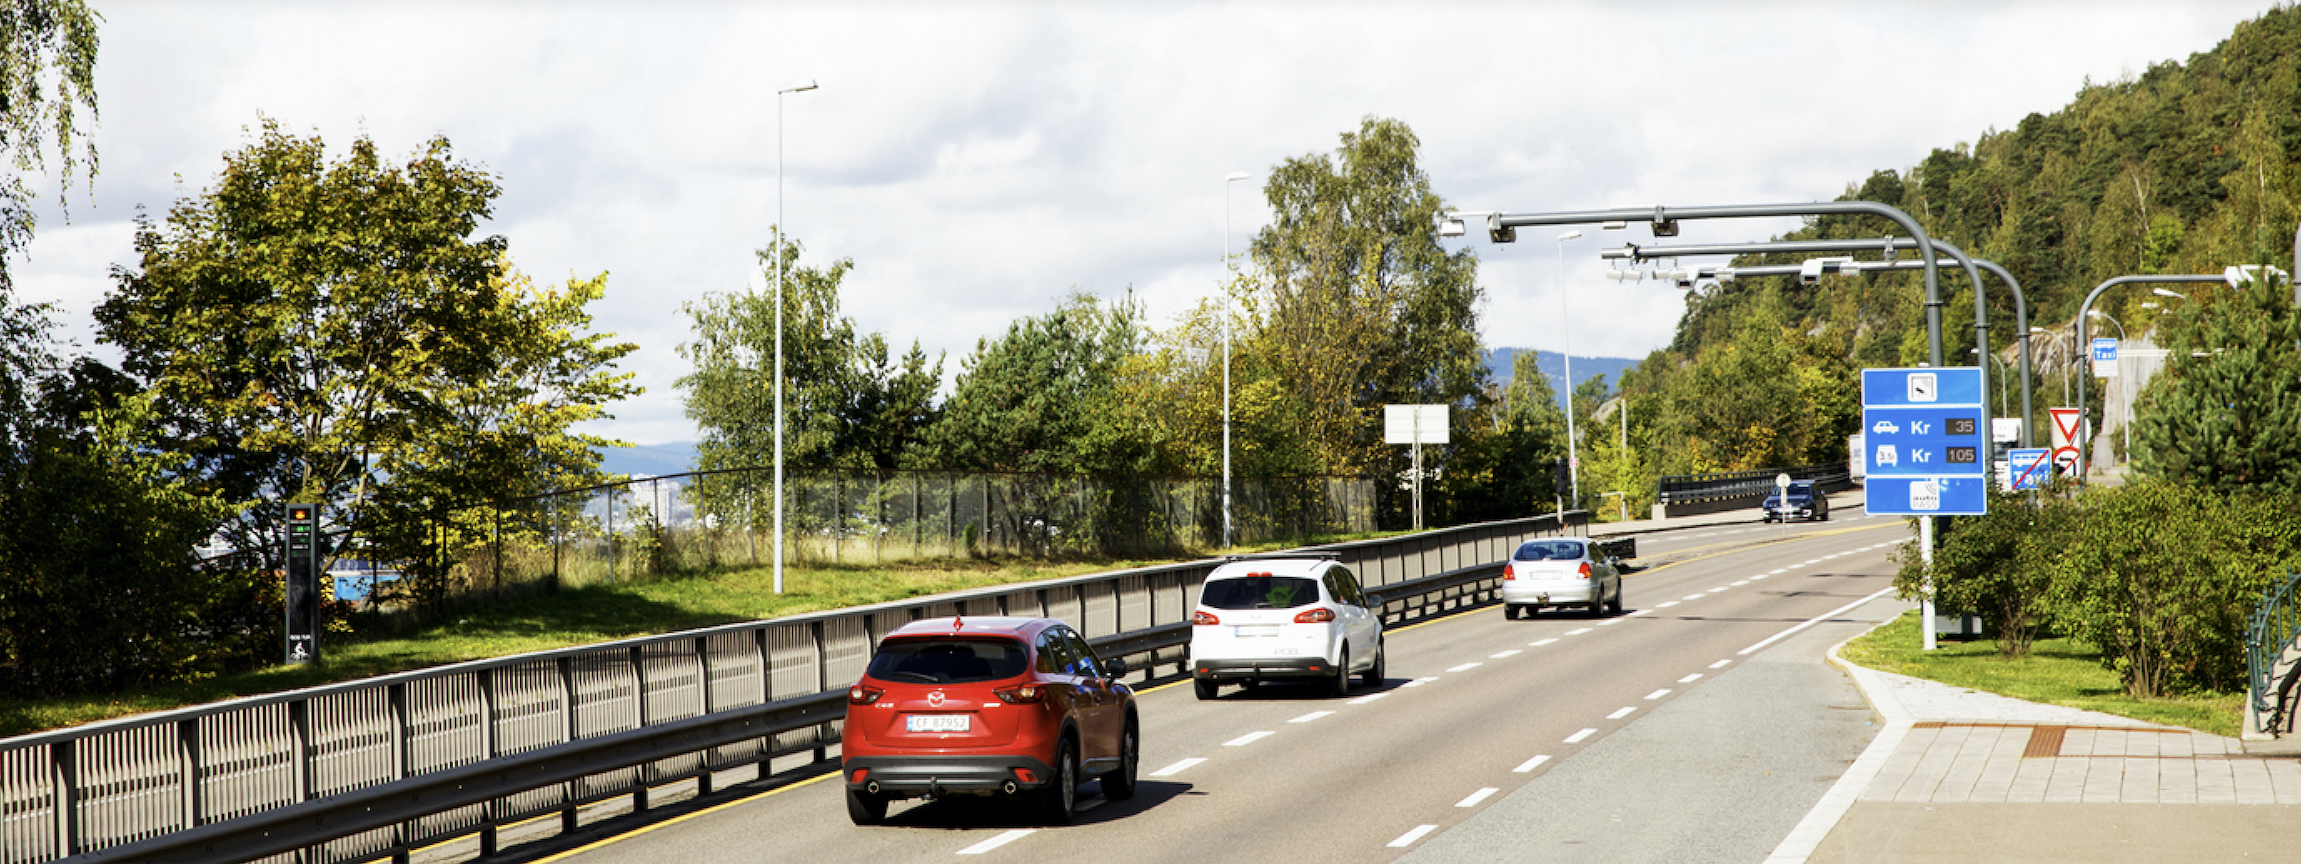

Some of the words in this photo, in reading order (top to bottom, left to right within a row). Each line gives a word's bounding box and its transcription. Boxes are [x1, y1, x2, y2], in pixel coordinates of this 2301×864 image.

[2096, 350, 2116, 358] Taxi
[1910, 421, 1931, 435] Kr
[1955, 420, 1974, 433] 35
[1912, 448, 1932, 463] Kr
[1950, 449, 1974, 461] 105
[916, 717, 928, 728] CF
[933, 717, 966, 728] 87952
